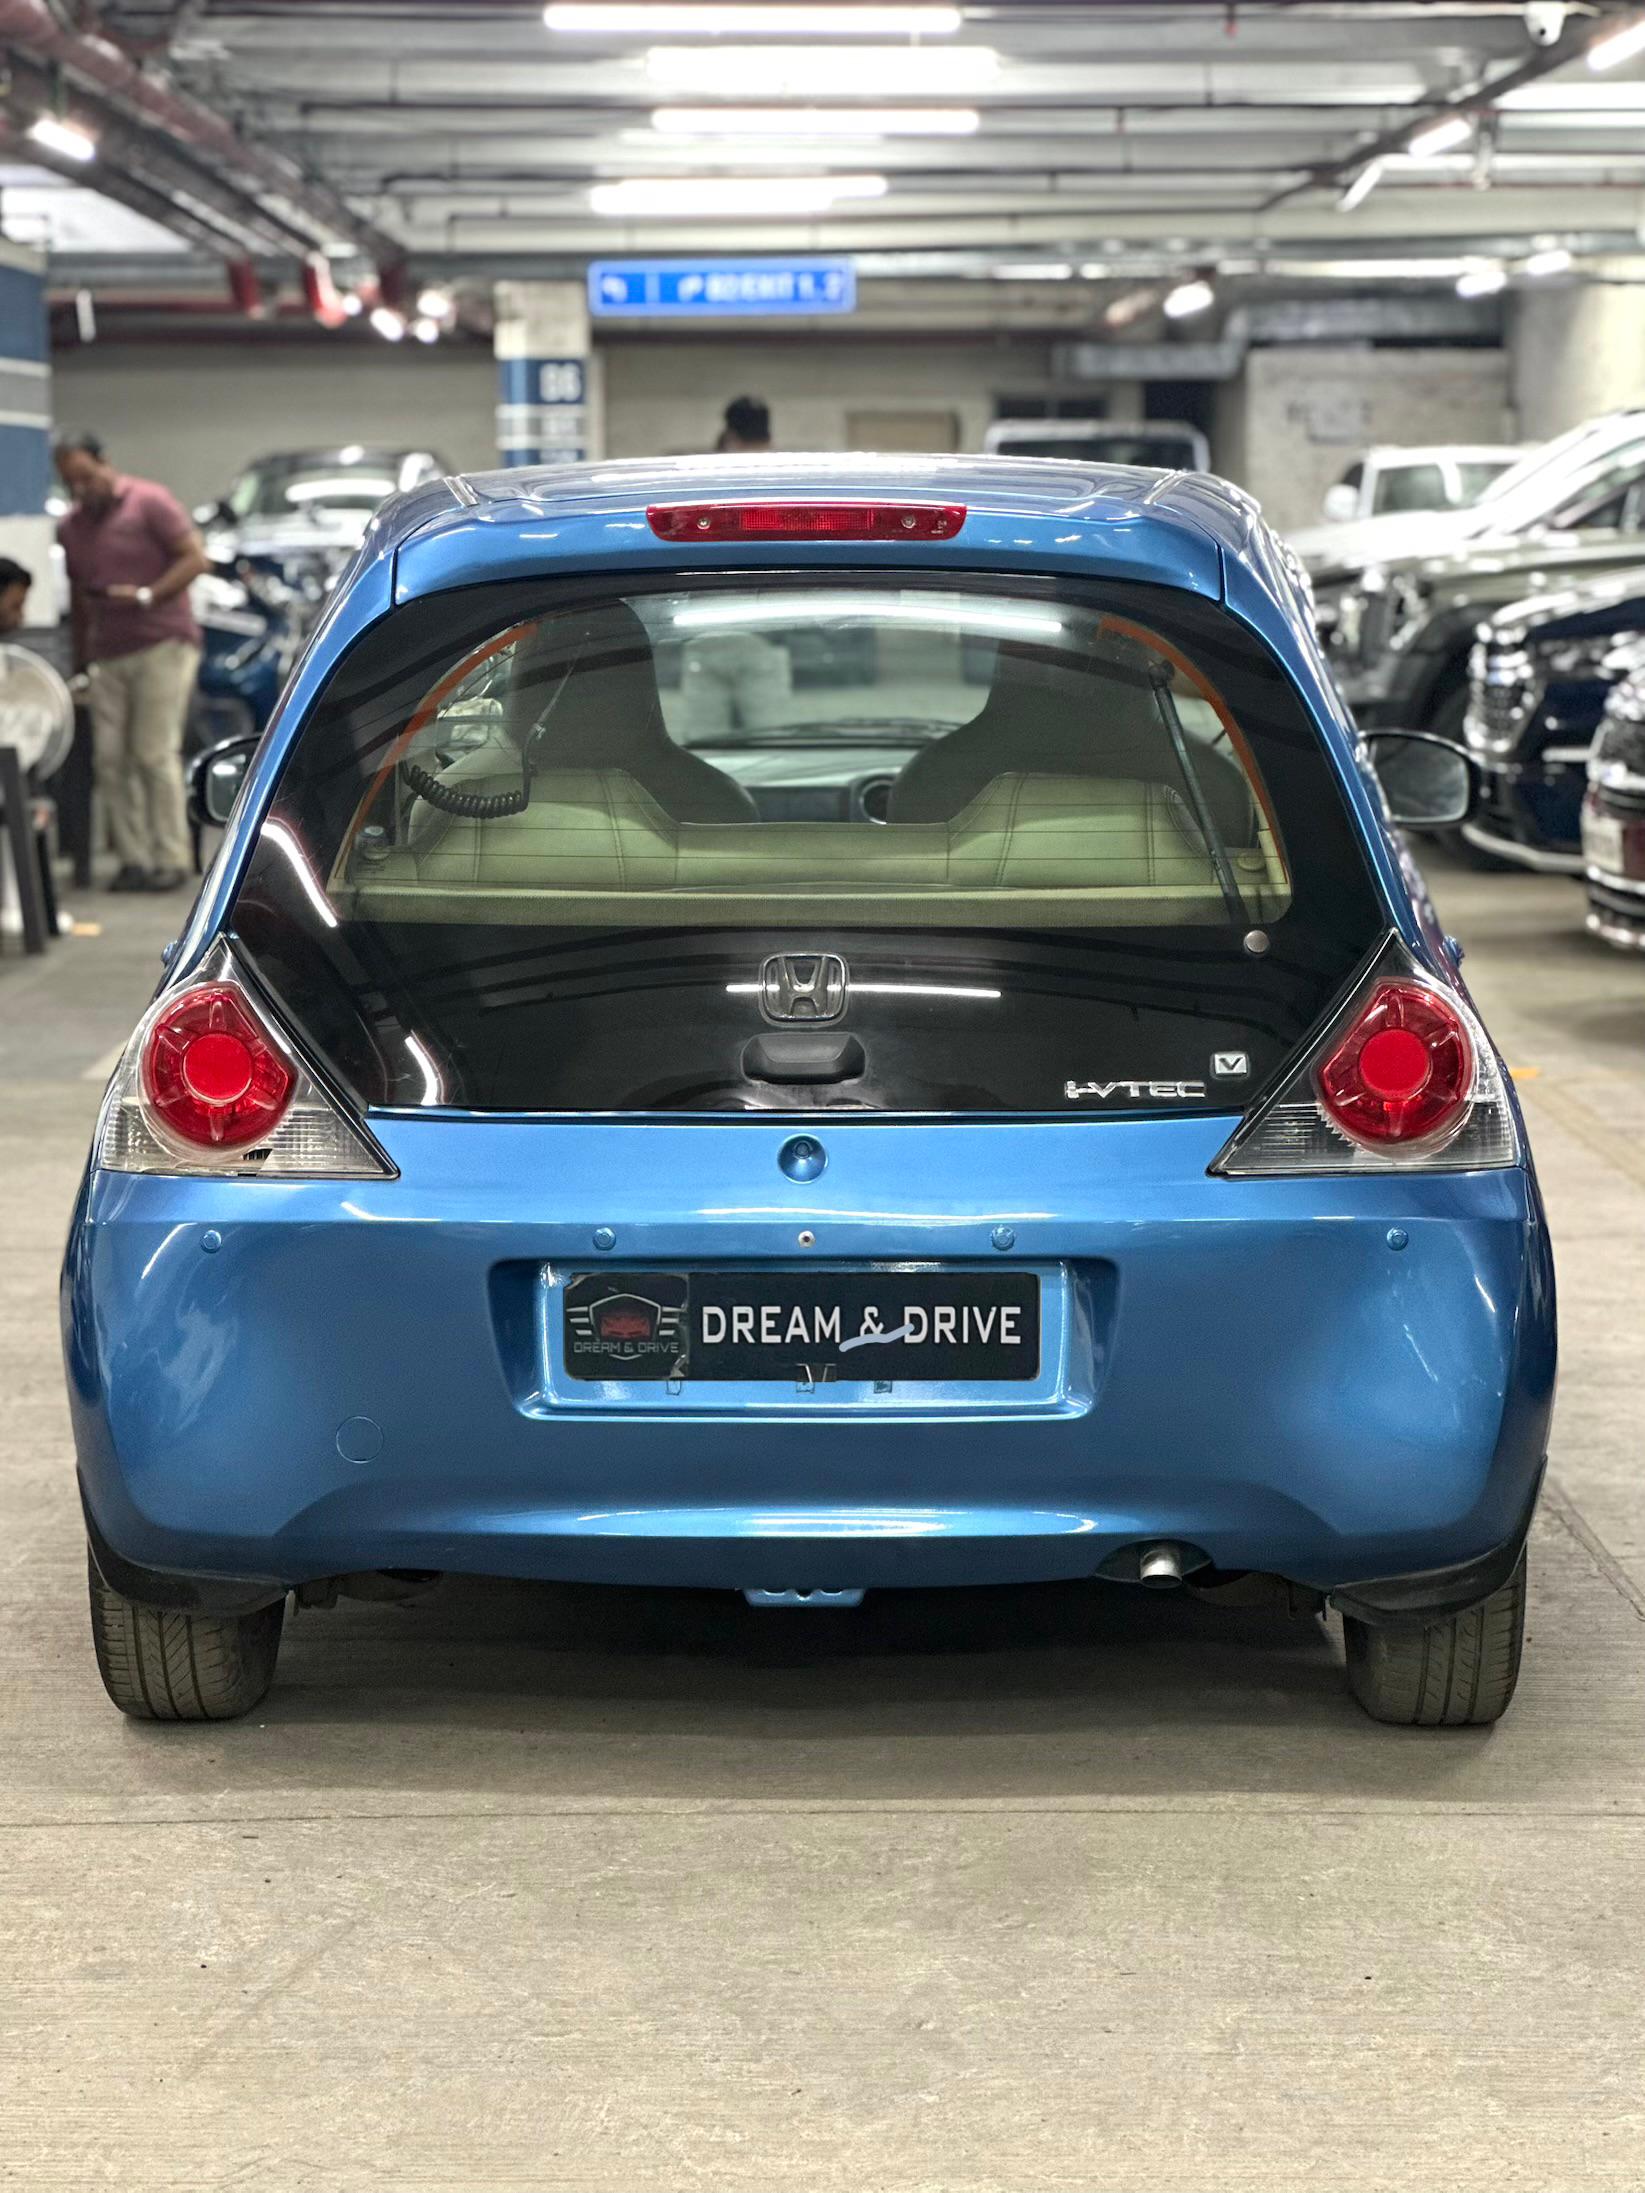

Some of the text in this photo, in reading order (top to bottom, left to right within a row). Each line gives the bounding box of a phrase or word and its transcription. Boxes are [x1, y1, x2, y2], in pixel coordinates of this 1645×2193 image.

[1218, 1056, 1243, 1071] V
[702, 1306, 1021, 1344] DREAM & DRIVE
[573, 1341, 621, 1353] DREAM
[637, 1341, 679, 1353] DRIVE
